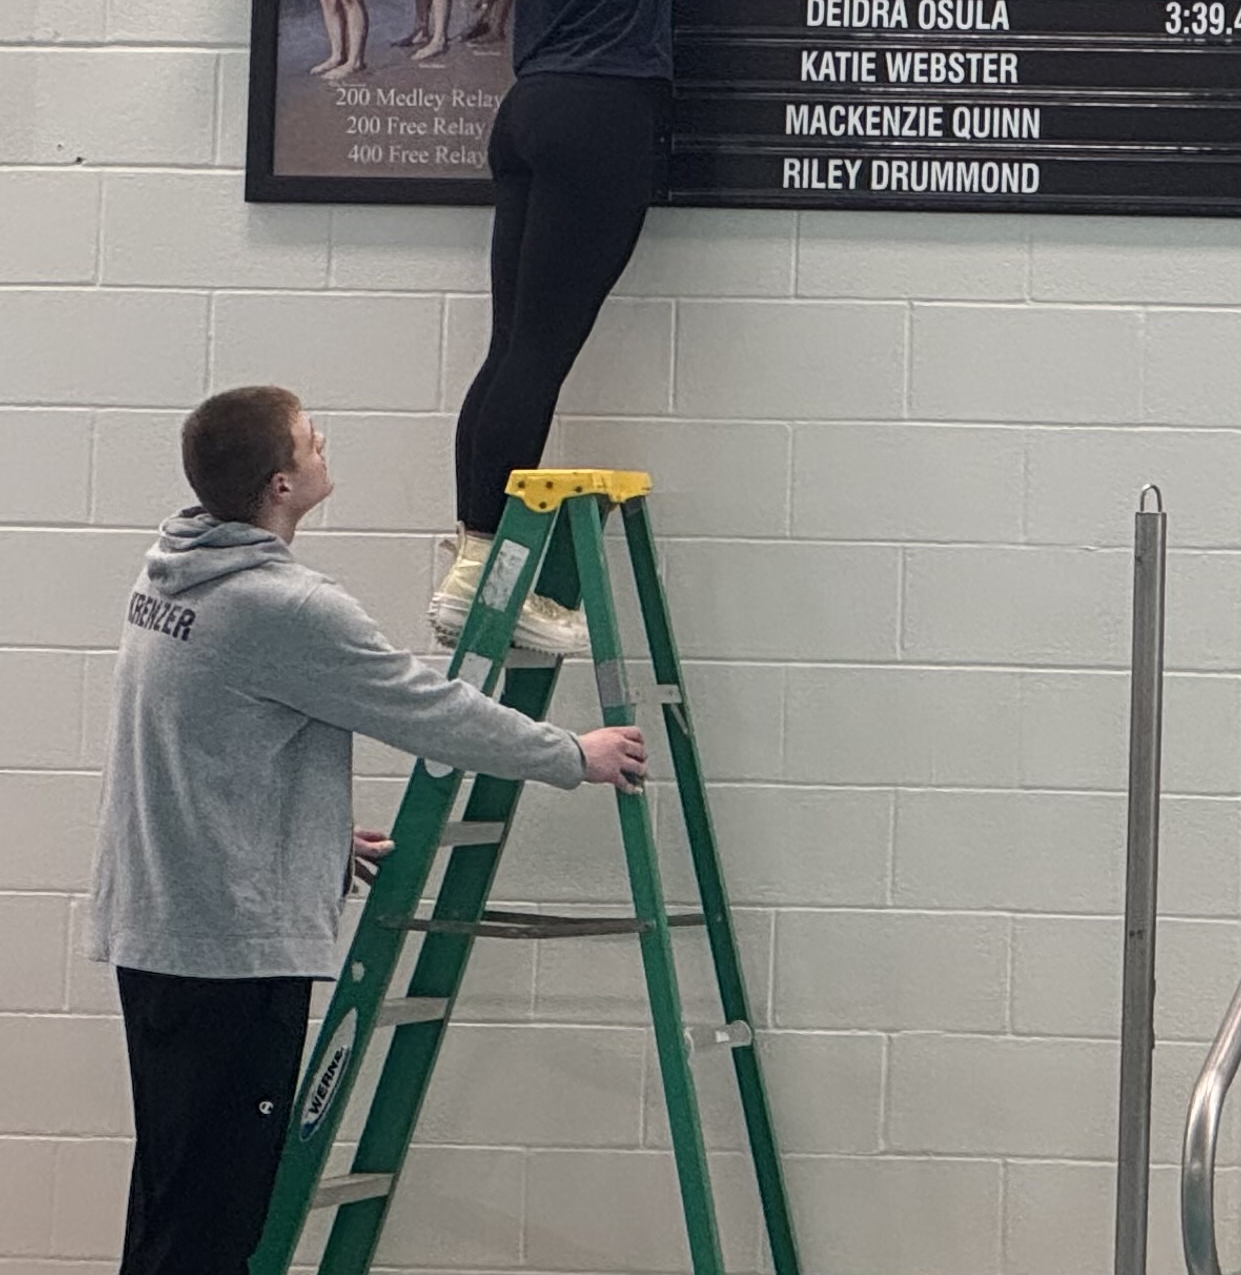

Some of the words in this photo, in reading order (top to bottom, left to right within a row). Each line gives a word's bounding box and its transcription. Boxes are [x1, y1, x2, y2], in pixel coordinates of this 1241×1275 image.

[336, 88, 370, 106] 200
[376, 88, 445, 111] Medley
[452, 89, 502, 112] Relay
[346, 116, 381, 134] 200
[387, 117, 428, 135] Free
[433, 118, 487, 140] Relay
[348, 145, 383, 163] 400
[389, 145, 429, 164] Free
[435, 146, 487, 168] Relay
[308, 1047, 346, 1115] WERNE
